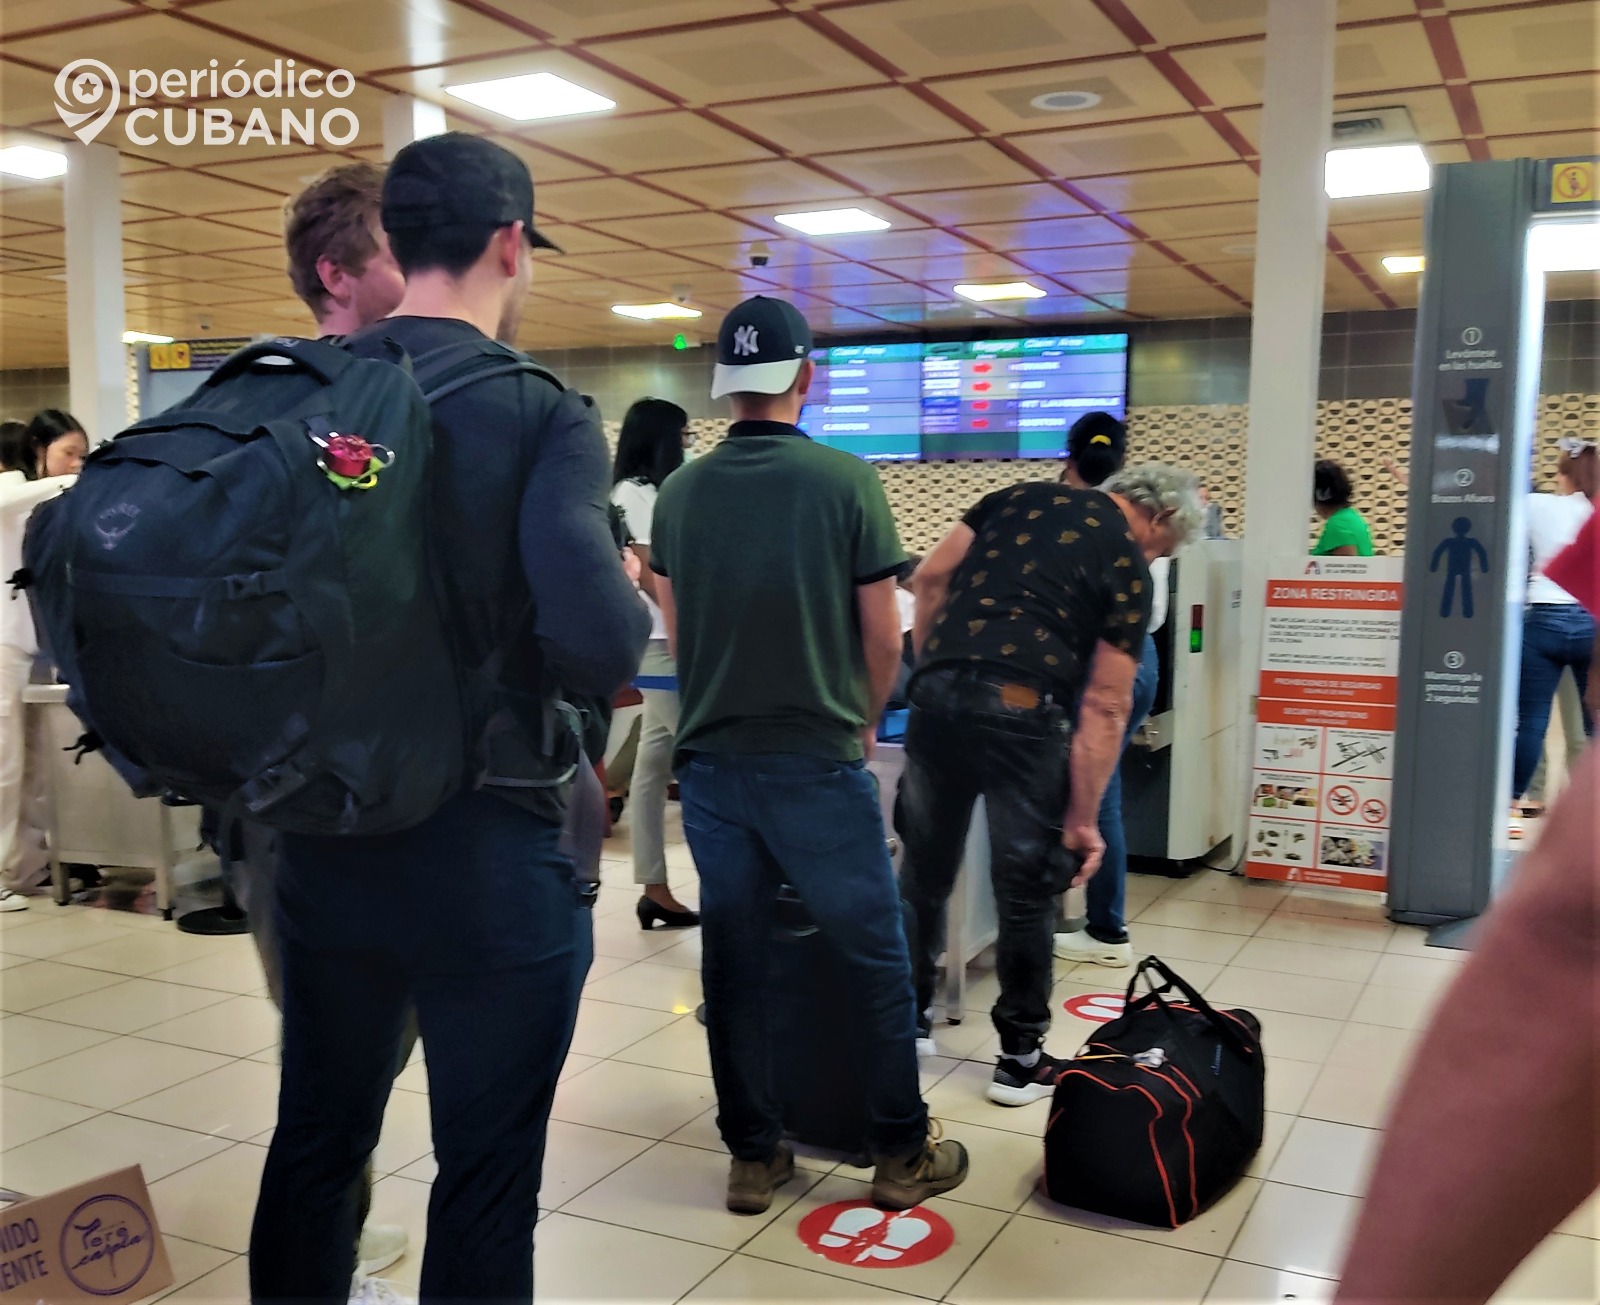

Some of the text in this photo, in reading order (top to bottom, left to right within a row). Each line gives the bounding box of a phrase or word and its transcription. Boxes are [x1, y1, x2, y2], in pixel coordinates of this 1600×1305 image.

[733, 325, 760, 356] NY
[1272, 587, 1398, 602] ZONA RESTRINGIDA
